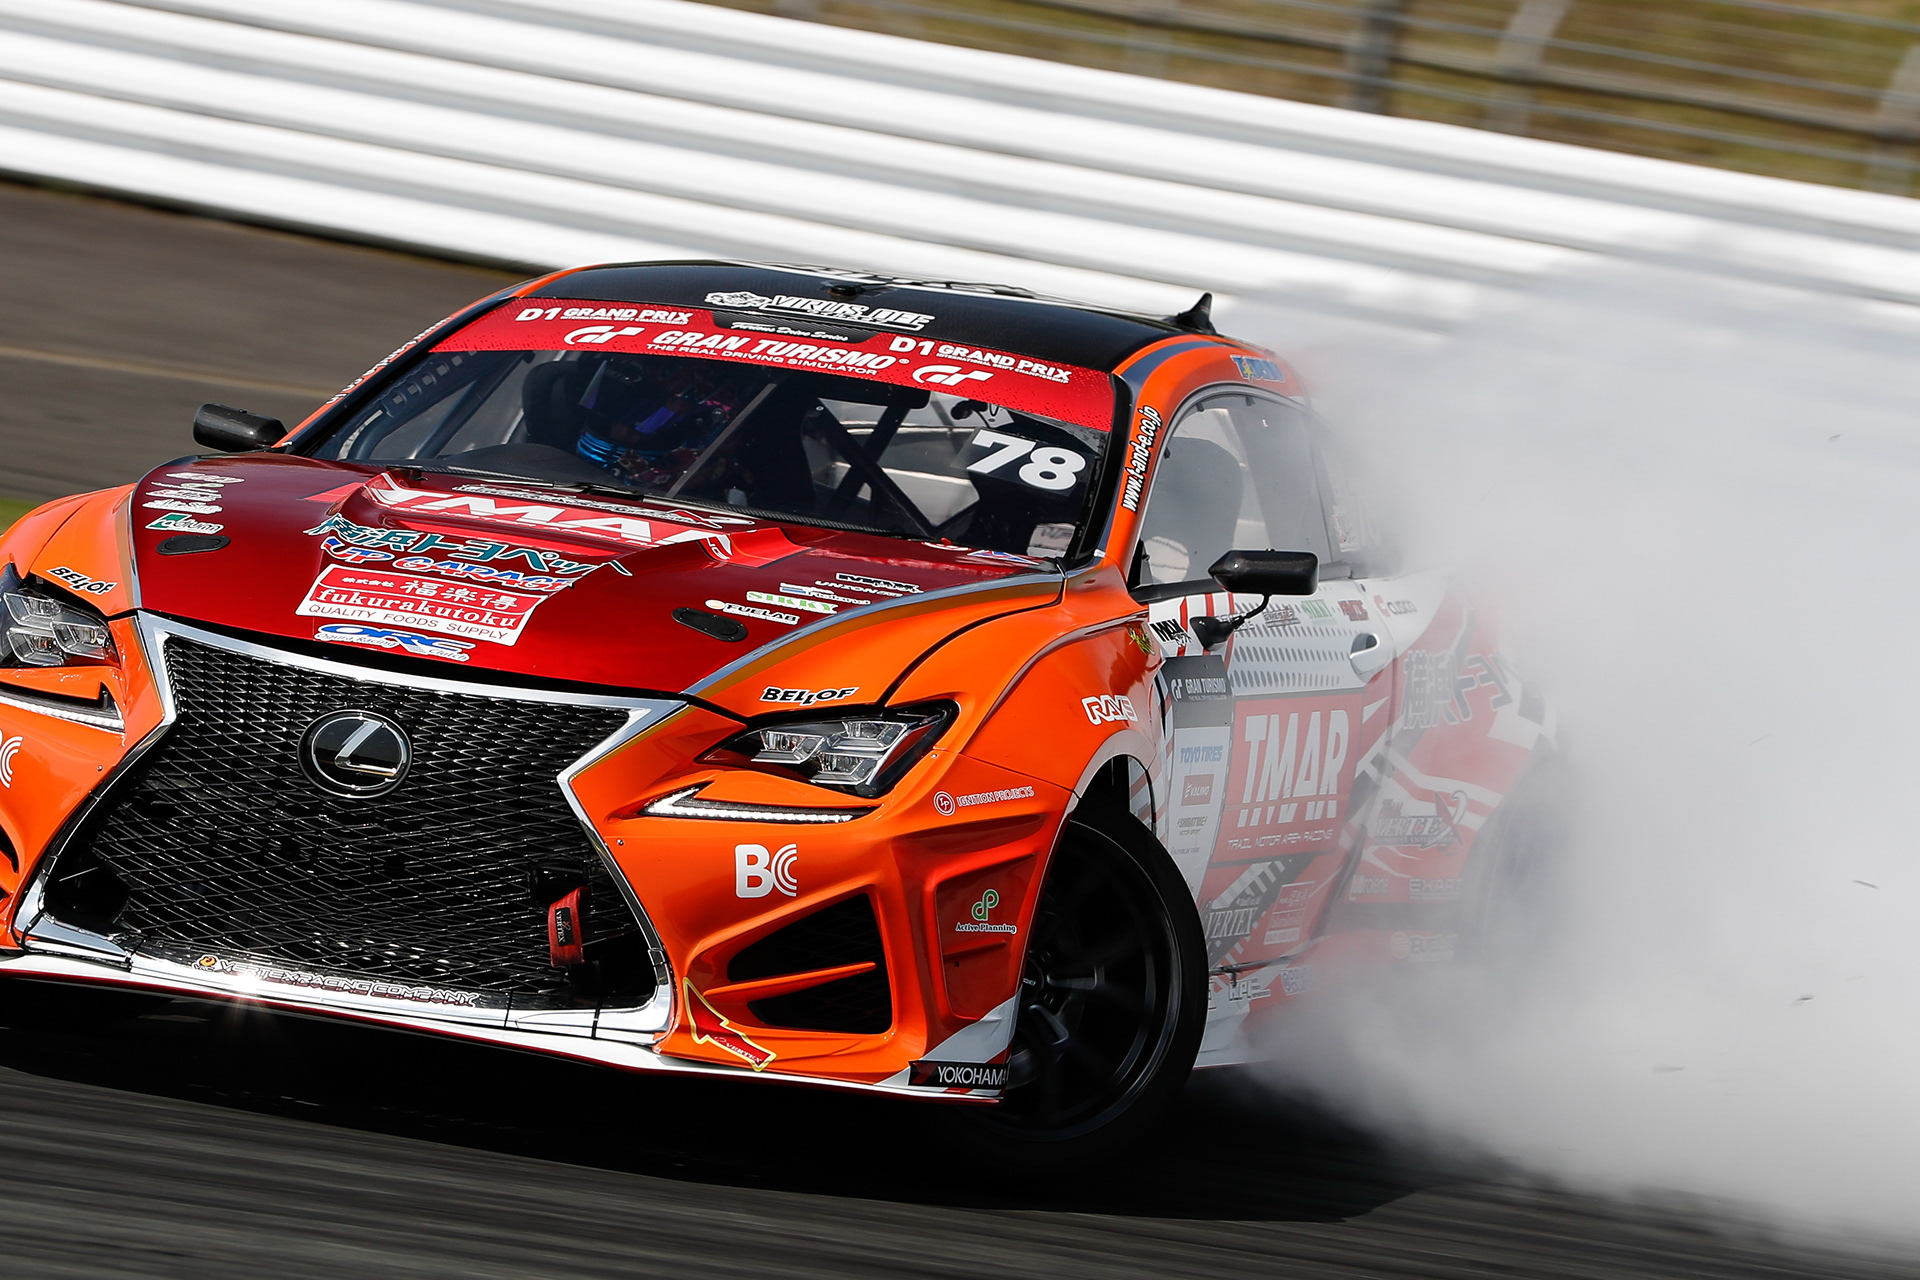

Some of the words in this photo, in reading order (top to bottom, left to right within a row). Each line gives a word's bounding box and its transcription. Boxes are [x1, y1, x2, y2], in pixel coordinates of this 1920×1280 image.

[515, 307, 562, 321] D1
[563, 307, 638, 318] GRAND
[639, 309, 694, 323] PRIX
[646, 344, 679, 352] THE
[680, 346, 718, 357] REAL
[721, 350, 784, 364] DRIVING
[787, 358, 878, 376] SIMULATOR
[652, 330, 750, 352] GRAN
[750, 339, 897, 370] TURISMO
[889, 336, 936, 356] D1
[938, 344, 1016, 366] GRAND
[1017, 359, 1072, 381] PRIX
[966, 429, 1086, 490] 78
[1122, 405, 1162, 512] www.t-and-e.co.jp
[321, 536, 396, 564] UP
[392, 555, 574, 592] GARAGE
[49, 567, 116, 594] BELLOF
[399, 580, 518, 610] 福楽得
[308, 604, 377, 619] QUALITY
[383, 612, 439, 628] FOODS
[446, 622, 509, 640] SUPPLY
[315, 589, 517, 628] fukurakutoku
[726, 605, 798, 622] FUELAB
[761, 686, 860, 706] BELLOF
[1185, 678, 1202, 694] GRAN
[1201, 677, 1227, 693] TURISMO
[1082, 694, 1138, 725] RAYS
[1180, 746, 1202, 764] TOYO
[1200, 745, 1223, 762] TIRES
[1237, 709, 1350, 828] TMAR
[956, 792, 996, 807] IGNITION
[995, 786, 1035, 801] PROJECTS
[955, 922, 979, 932] Active
[980, 923, 1017, 934] Planning
